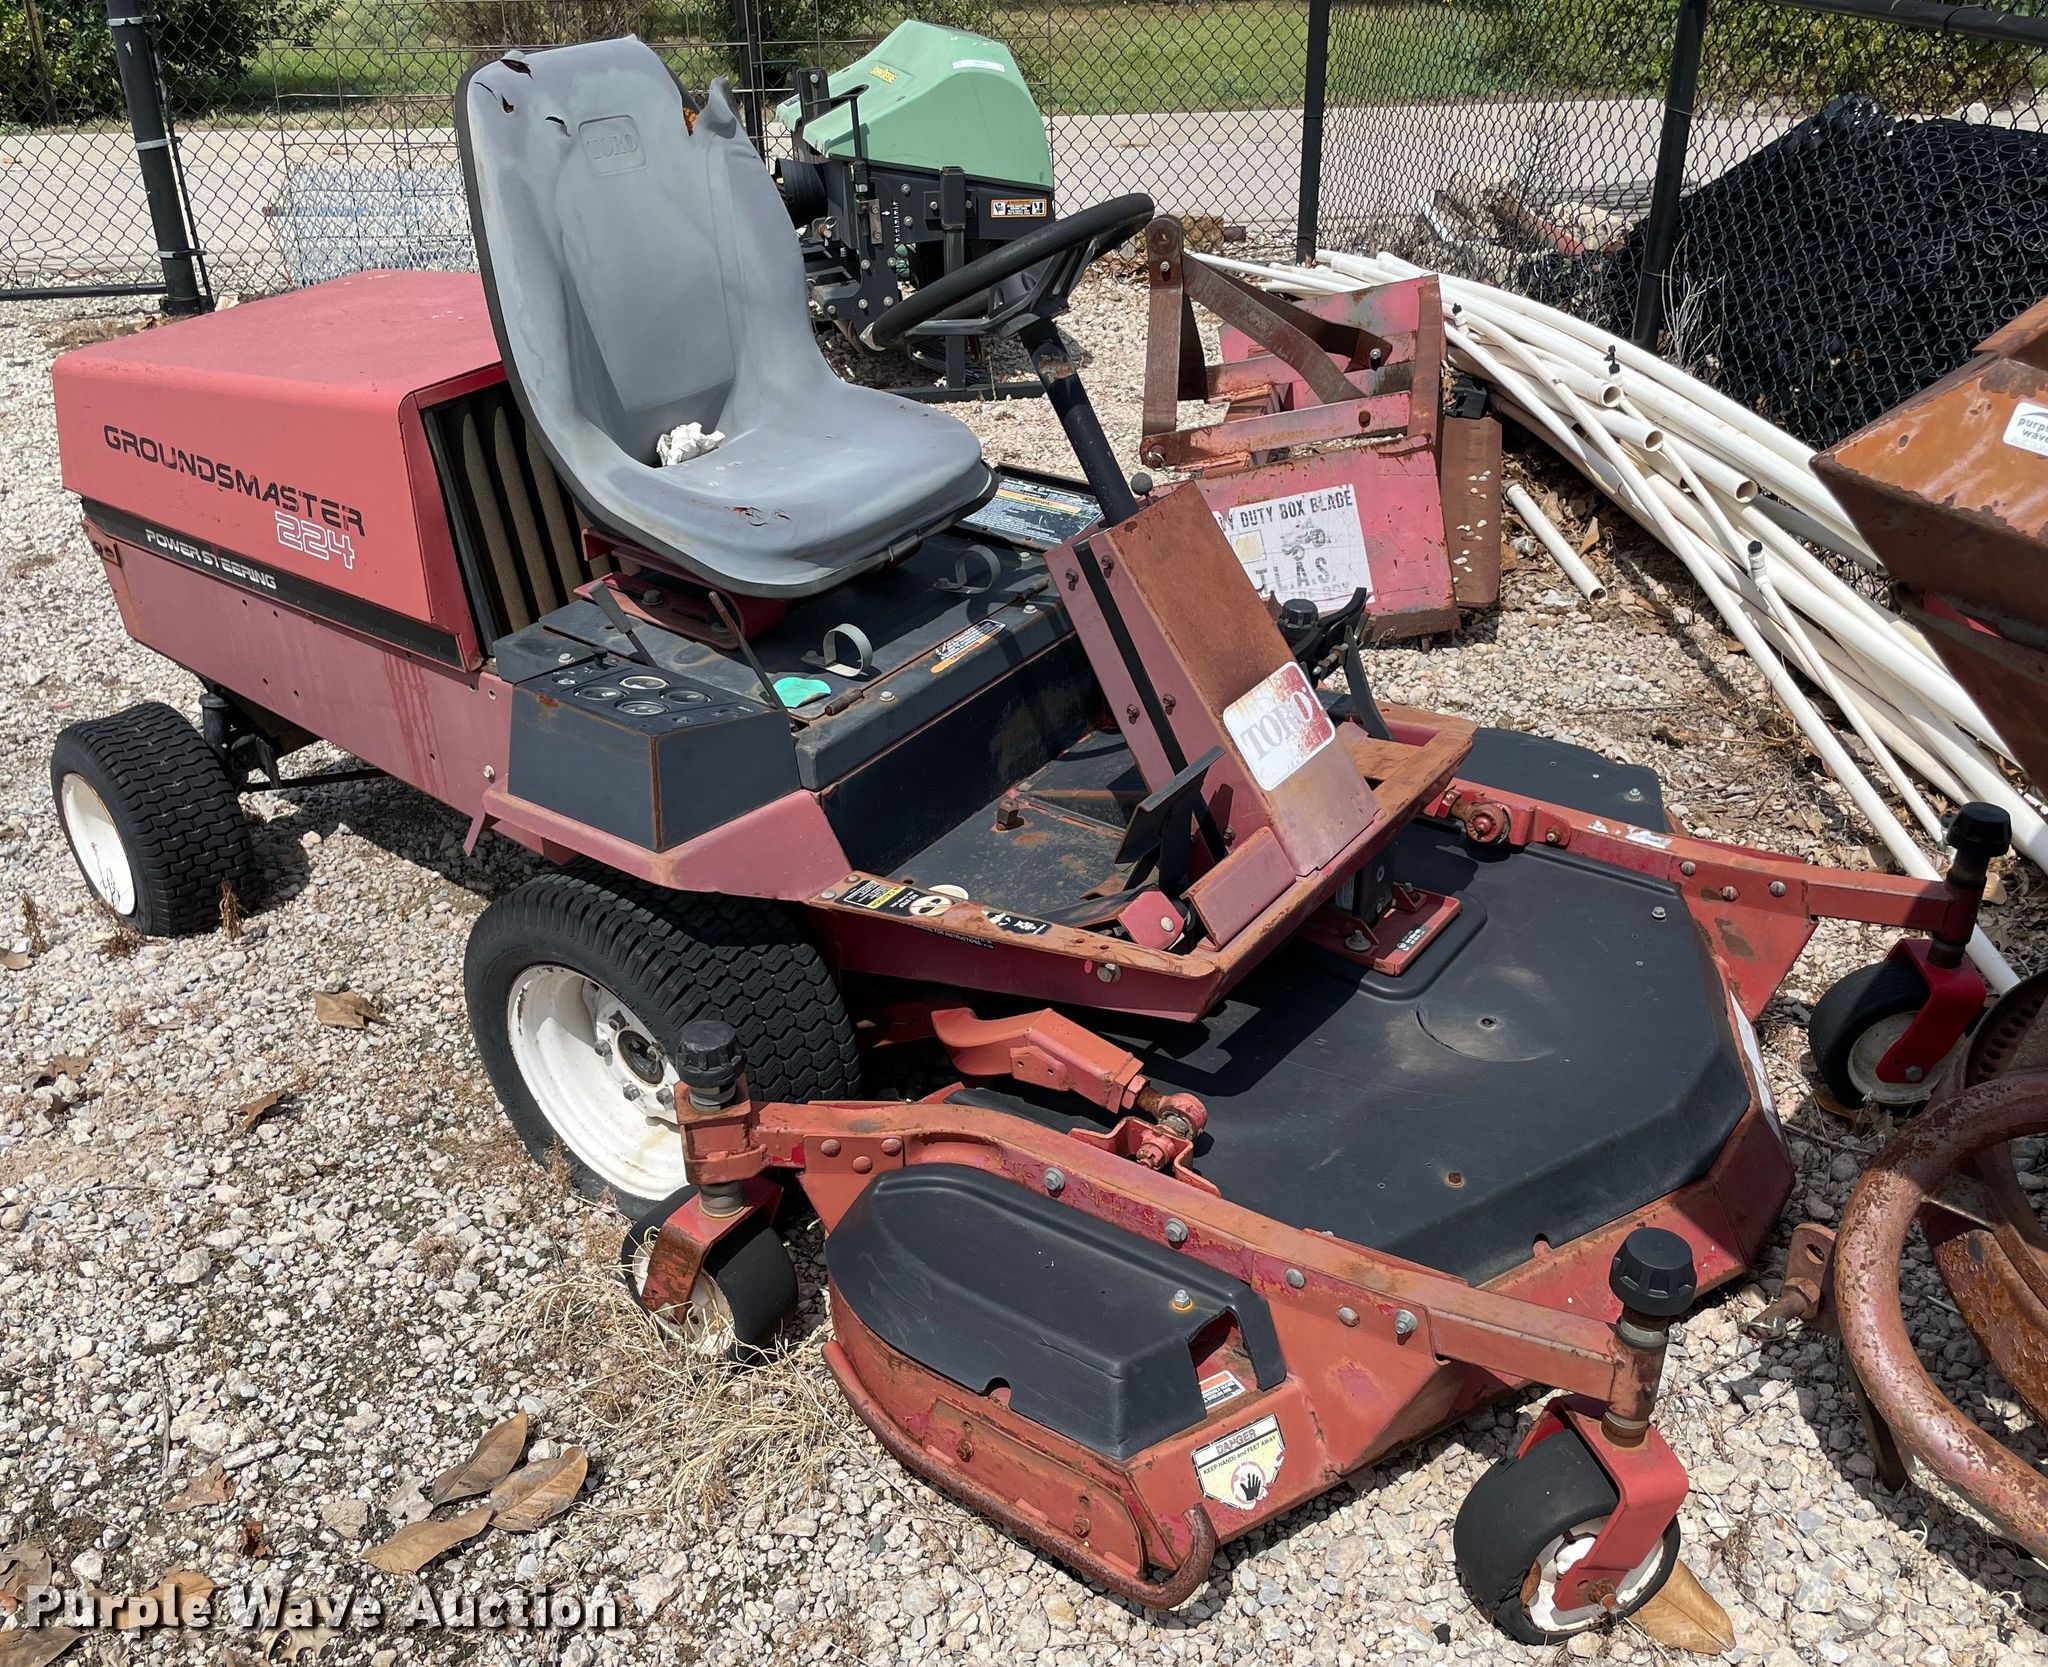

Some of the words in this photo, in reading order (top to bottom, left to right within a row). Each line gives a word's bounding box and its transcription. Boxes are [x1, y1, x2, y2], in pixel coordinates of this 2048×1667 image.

[586, 132, 638, 160] TORO
[103, 424, 366, 537] GROUNDSMASTER
[1240, 507, 1274, 528] DUTY
[1279, 499, 1306, 520] BOX
[1310, 490, 1353, 513] BLADE
[145, 528, 204, 562] POWER
[201, 552, 277, 590] STEERING
[274, 510, 355, 571] 224
[1240, 691, 1314, 761] TORO
[1203, 1464, 1218, 1474] KEEP
[1218, 1455, 1237, 1467] HANDS
[1237, 1449, 1247, 1458] and
[1247, 1443, 1260, 1455] FEET
[1261, 1435, 1277, 1446] AWAY
[1215, 1428, 1257, 1455] DANGER
